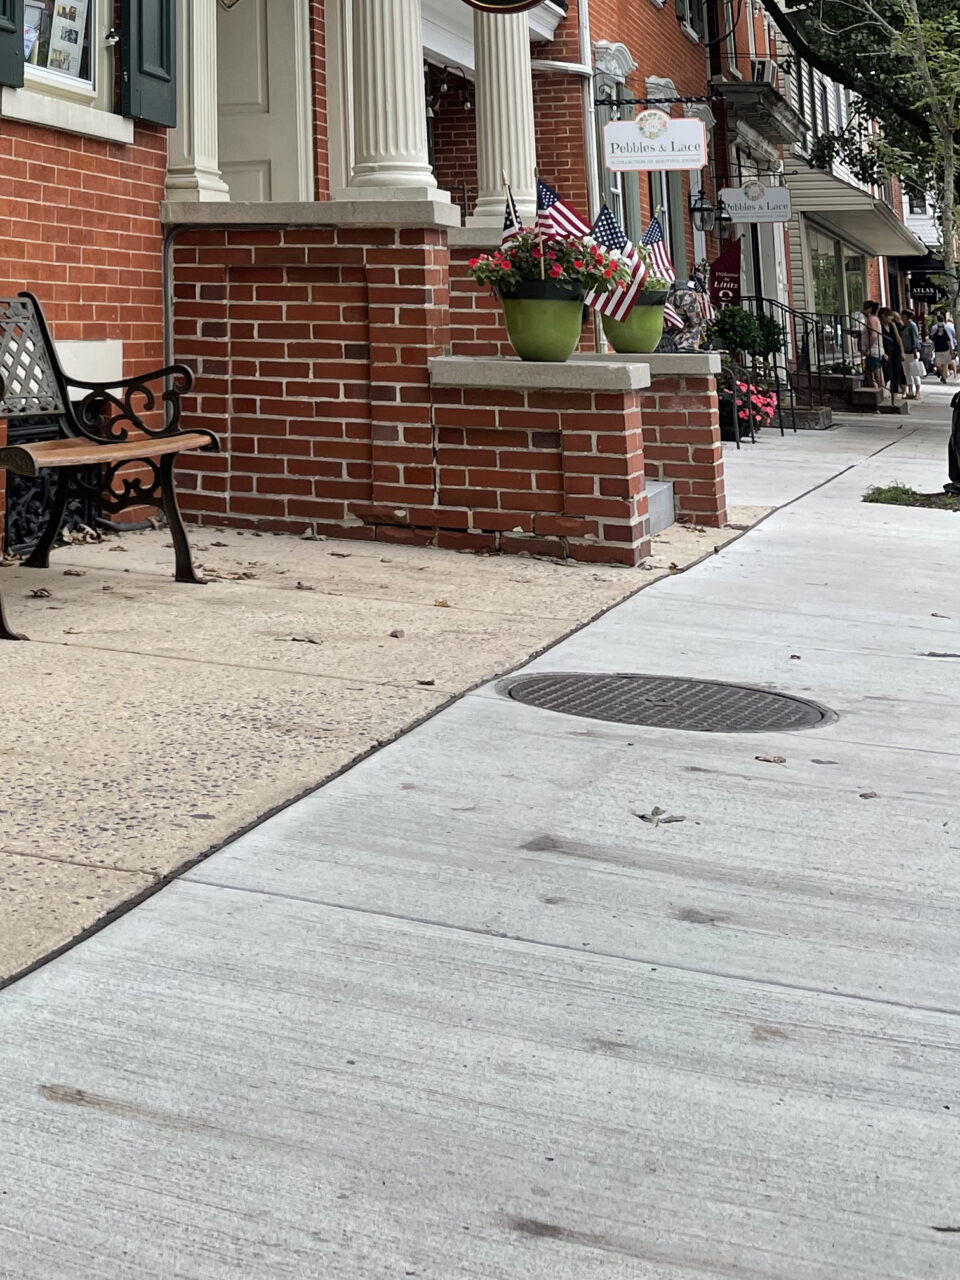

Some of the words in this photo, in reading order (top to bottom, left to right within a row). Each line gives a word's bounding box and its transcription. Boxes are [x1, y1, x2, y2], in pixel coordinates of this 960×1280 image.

[610, 141, 656, 155] Pebbles
[659, 143, 667, 153] &
[671, 140, 701, 153] Lace
[767, 201, 789, 211] Lace
[714, 281, 738, 289] Lititz
